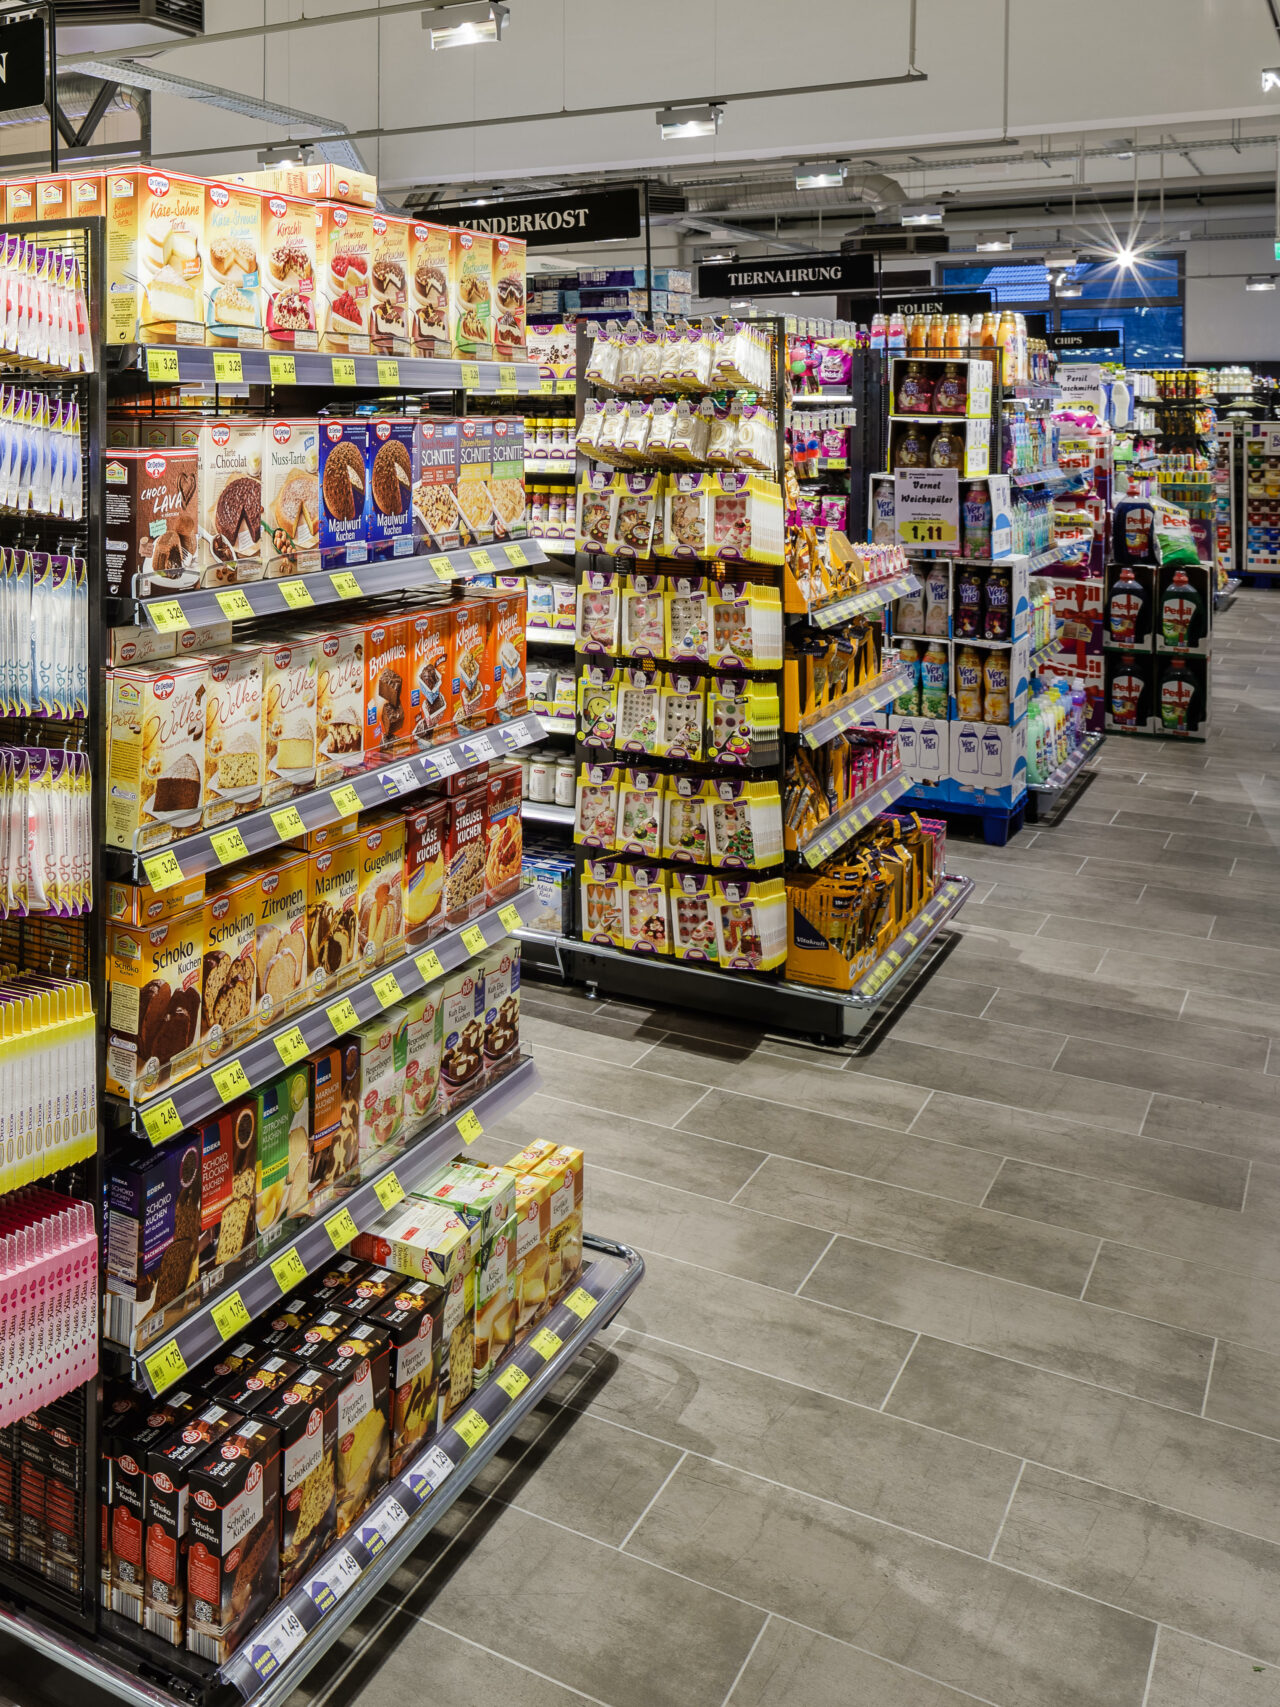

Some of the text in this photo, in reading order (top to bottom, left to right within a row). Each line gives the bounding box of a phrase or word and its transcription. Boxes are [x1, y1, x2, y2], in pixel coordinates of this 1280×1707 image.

[150, 200, 199, 217] Käse-Sahne
[170, 221, 186, 230] Torte
[458, 209, 589, 235] KINDERKOST
[728, 266, 842, 286] TIERNAHRUNG
[897, 302, 943, 314] FOLIEN
[164, 358, 177, 370] 3,29
[229, 361, 241, 372] 3,29
[284, 363, 294, 373] 3,29
[344, 365, 354, 375] 3,29
[1067, 374, 1087, 382] Persil
[224, 448, 236, 456] Tarte
[272, 452, 305, 466] Nuss-Tarte
[422, 449, 455, 465] SCHNITTE
[461, 447, 491, 463] SCHNITTE
[493, 446, 523, 461] SCHNITTE
[216, 455, 247, 468] Chocolat
[141, 485, 167, 500] CHOCO
[913, 481, 941, 490] Vernel
[153, 493, 182, 513] LAVA
[877, 499, 892, 510] Ver
[901, 495, 953, 504] Weichspüler
[967, 505, 981, 515] Ver
[971, 514, 985, 522] nel
[329, 518, 361, 532] Maulwurf
[377, 512, 408, 527] Maulwurf
[336, 531, 355, 542] Kuchen
[384, 525, 402, 536] Kuchen
[912, 526, 942, 541] 1,11
[294, 587, 308, 598] 3,29
[930, 583, 945, 593] Ver
[988, 586, 1003, 596] Ver
[233, 597, 248, 608] 3,29
[1111, 601, 1139, 611] Persil
[167, 608, 183, 621] 3,29
[1164, 606, 1192, 616] Persil
[497, 613, 518, 640] Kleine
[456, 622, 479, 650] Kleine
[415, 631, 440, 660] Kleine
[369, 643, 406, 680] Brownies
[425, 647, 445, 662] Kuchen
[926, 664, 941, 675] Ver
[958, 666, 973, 677] Ver
[930, 674, 944, 682] nel
[962, 675, 978, 685] nel
[1113, 683, 1140, 693] Persil
[1162, 688, 1190, 698] Persil
[456, 809, 483, 831] STREUSEL
[229, 835, 243, 849] 3,29
[422, 829, 437, 844] KÄSE
[457, 825, 482, 844] KUCHEN
[364, 844, 403, 874] Gugelhupf
[416, 842, 441, 863] KUCHEN
[164, 859, 177, 874] 3,29
[315, 868, 355, 896] Marmor
[339, 883, 358, 898] Kuchen
[261, 889, 303, 919] Zitronen
[287, 904, 306, 920] Kuchen
[208, 912, 254, 947] Schokino
[237, 929, 256, 946] Kuchen
[152, 941, 194, 973] Schoko
[177, 957, 202, 975] Kuchen
[290, 1034, 304, 1049] 2,49
[365, 1055, 392, 1075] Regenbogen
[232, 1070, 245, 1085] 2,49
[161, 1107, 177, 1126] 2,49
[262, 1113, 289, 1135] ZITRONEN
[202, 1152, 228, 1171] SCHOKO
[202, 1163, 229, 1182] FLOCKEN
[147, 1182, 165, 1197] EDEKA
[202, 1176, 225, 1192] KUCHEN
[146, 1193, 172, 1216] SCHOKO
[145, 1208, 168, 1226] KUCHEN
[288, 1258, 302, 1274] 1,79
[230, 1300, 243, 1318] 1,79
[166, 1346, 181, 1368] 1,79
[401, 1351, 423, 1370] Marmor
[406, 1358, 427, 1376] Kuchen
[341, 1393, 364, 1418] Zitronen
[347, 1402, 368, 1424] Kuchen
[120, 1460, 137, 1471] RUF
[287, 1448, 322, 1486] Schokoletto
[432, 1451, 448, 1469] 1,29
[156, 1478, 170, 1490] RUF
[247, 1470, 261, 1490] RUF
[116, 1482, 137, 1498] Schoko
[119, 1491, 141, 1507] Kuchen
[197, 1495, 213, 1508] RUF
[150, 1499, 171, 1516] Schoko
[387, 1503, 403, 1521] 1,29
[154, 1509, 175, 1526] Kuchen
[226, 1507, 250, 1533] Schoko
[191, 1518, 214, 1534] Schoko
[233, 1513, 256, 1539] Kuchen
[195, 1528, 219, 1544] Kuchen
[339, 1555, 357, 1577] 1,49
[281, 1615, 300, 1638] 1,49
